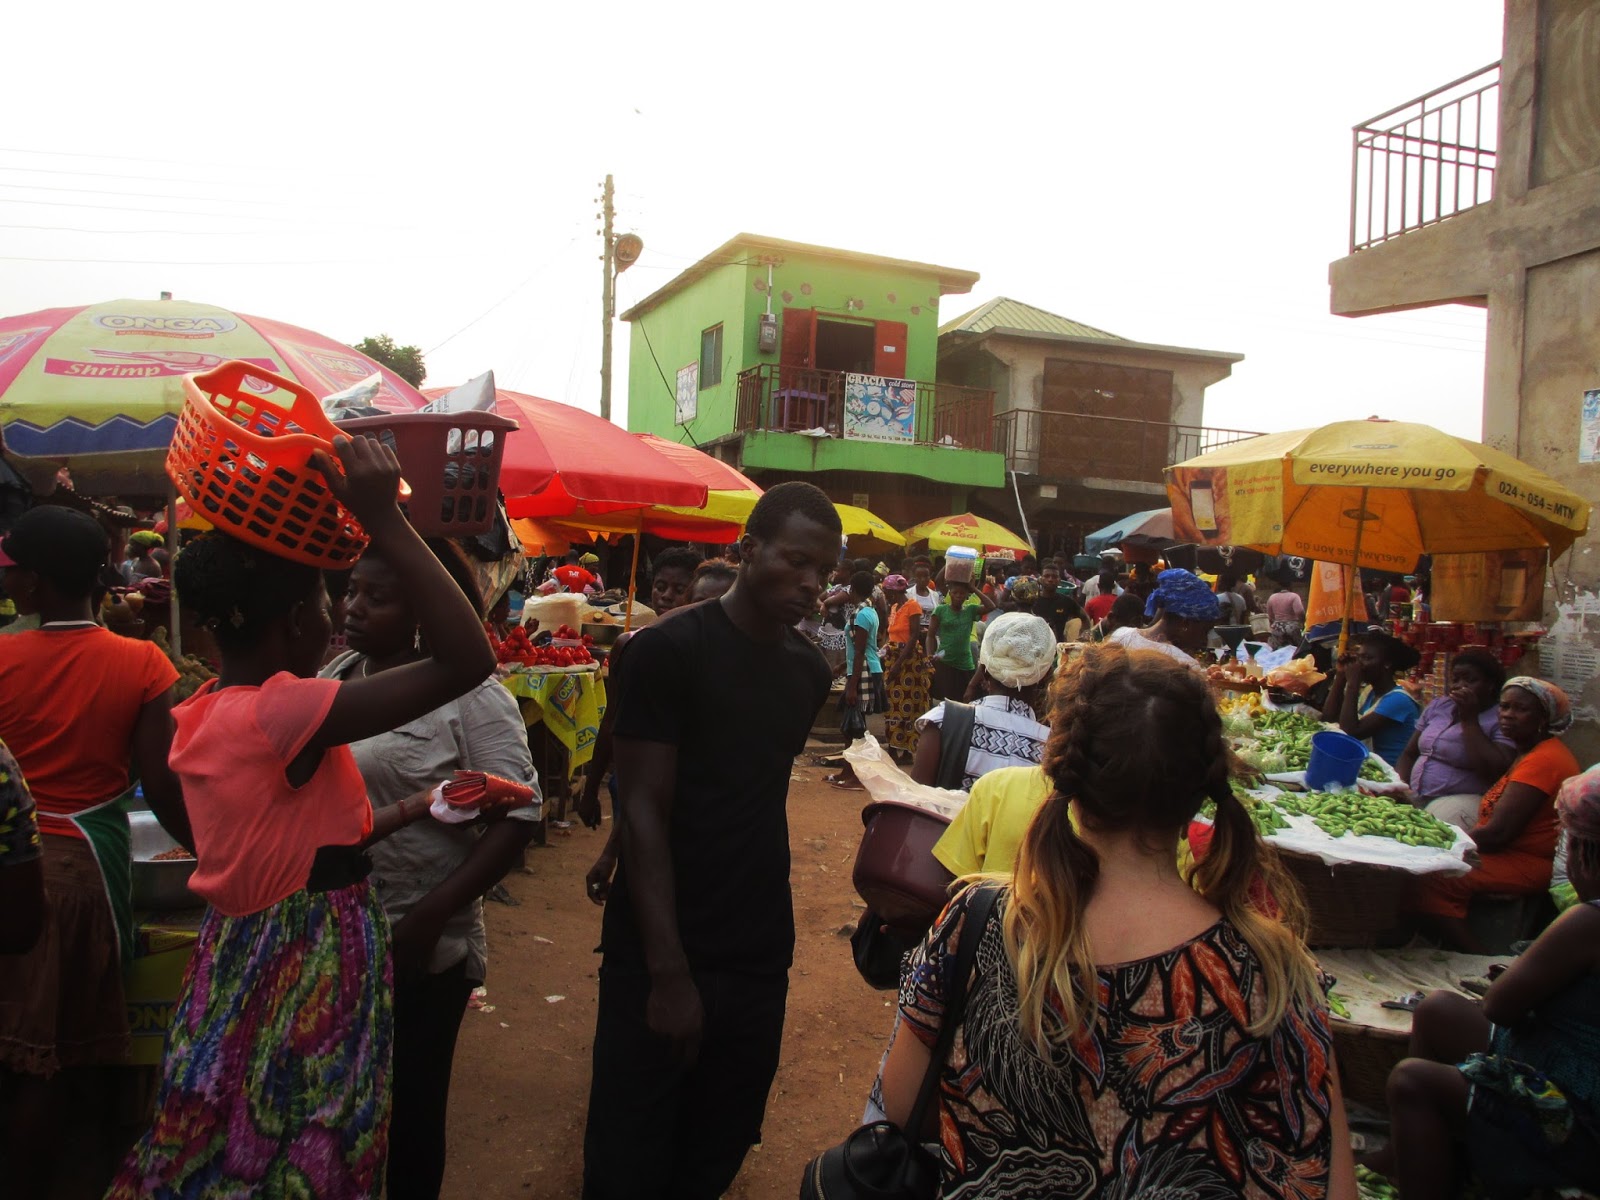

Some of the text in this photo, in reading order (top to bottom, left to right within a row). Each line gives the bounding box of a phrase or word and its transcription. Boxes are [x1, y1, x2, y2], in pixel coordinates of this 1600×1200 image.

[100, 314, 224, 331] ONGA
[65, 362, 161, 378] Shrimp
[848, 374, 886, 387] GRACIA
[1309, 463, 1456, 480] everywhere you go
[1499, 481, 1518, 498] 024
[1527, 493, 1545, 509] 054
[1554, 503, 1576, 520] MTN
[940, 530, 978, 539] MAGGI
